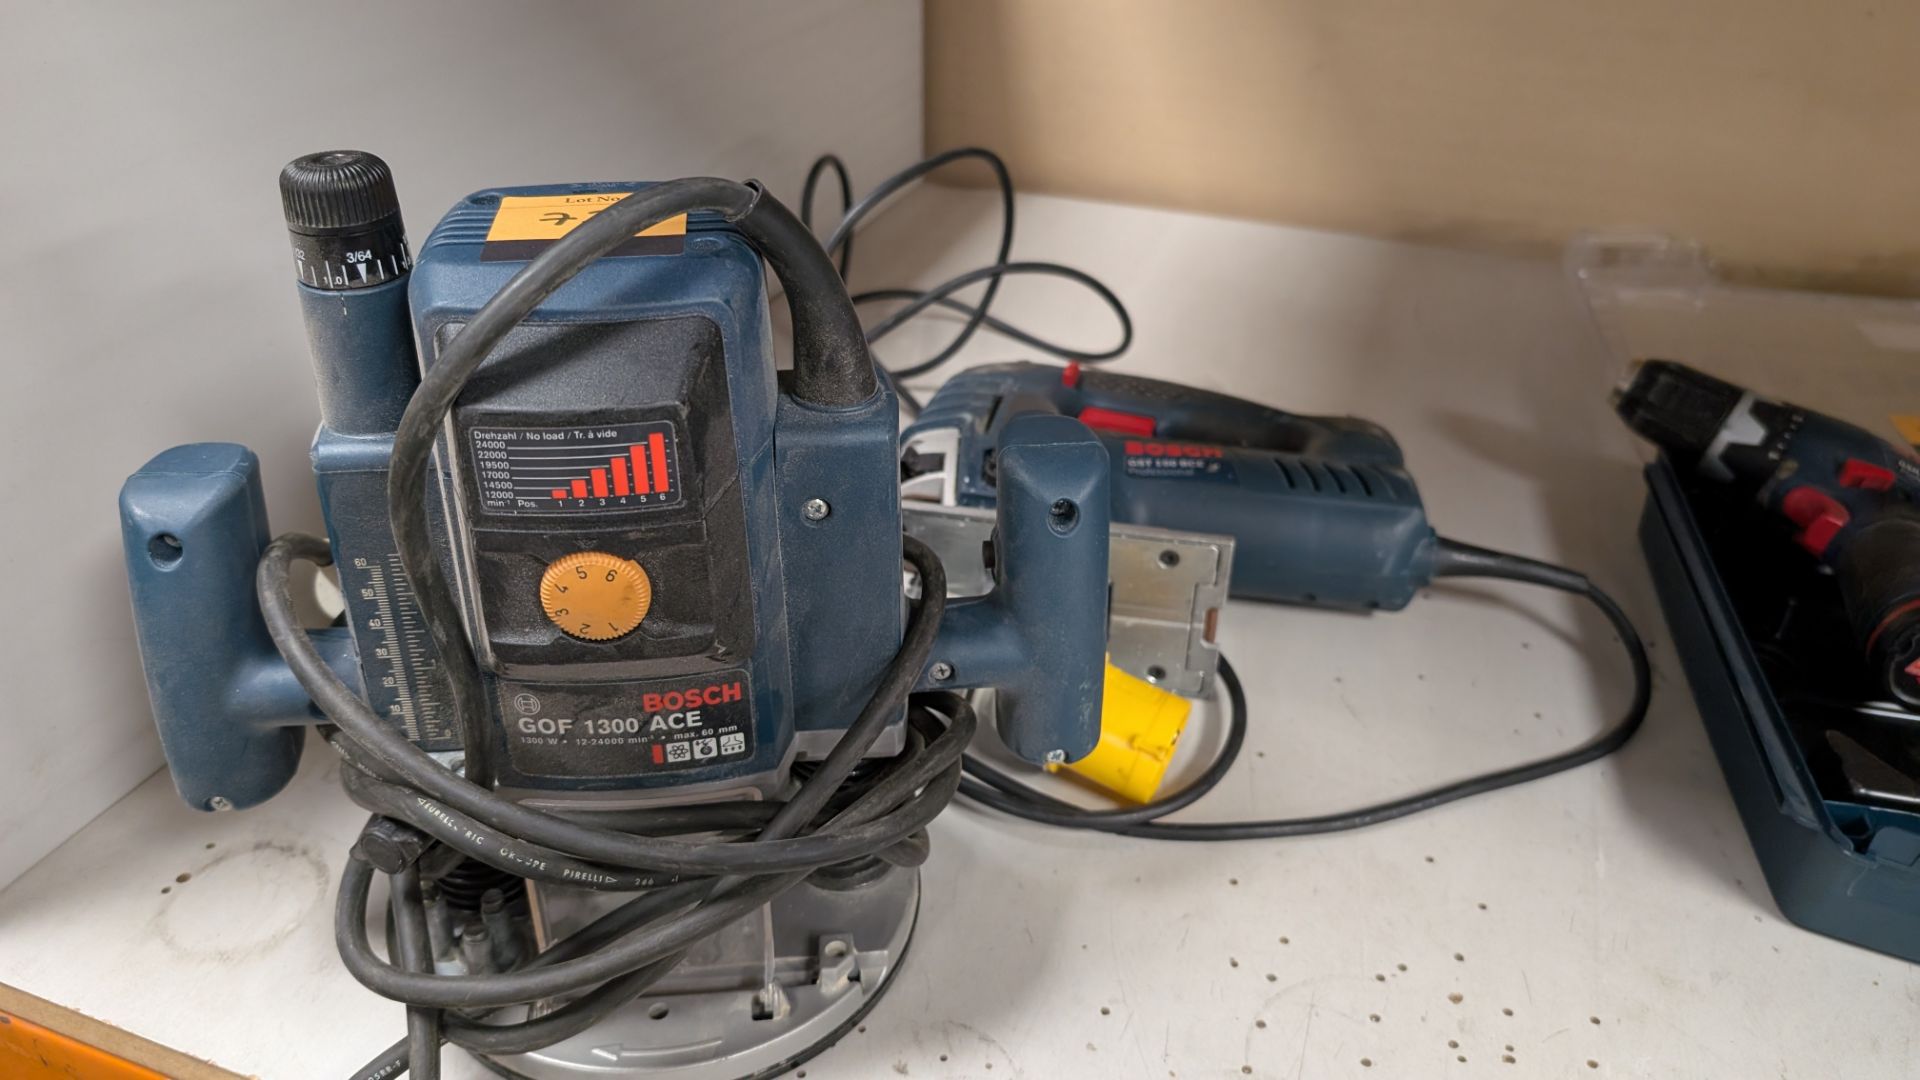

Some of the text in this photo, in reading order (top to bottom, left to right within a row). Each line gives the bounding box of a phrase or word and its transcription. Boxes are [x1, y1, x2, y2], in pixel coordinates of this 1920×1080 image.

[346, 249, 372, 264] 3/64
[474, 430, 517, 440] Drehzahl
[526, 432, 540, 440] No
[543, 432, 564, 440] load
[574, 431, 586, 439] Tr.
[588, 430, 594, 439] à
[597, 429, 617, 438] vide
[476, 441, 506, 449] 24000
[478, 451, 507, 459] 22000
[480, 461, 510, 469] 19500
[482, 471, 510, 479] 17000
[485, 491, 514, 499] 12000
[518, 500, 538, 508] Pos.
[354, 558, 367, 566] 60
[576, 566, 618, 582] 5 6
[362, 588, 374, 597] 50
[555, 584, 568, 593] 4
[555, 608, 569, 616] 3
[369, 619, 381, 627] 40
[580, 622, 618, 634] 2 1
[376, 648, 388, 656] 30
[382, 677, 394, 685] 20
[642, 682, 742, 713] BOSCH
[518, 711, 702, 734] GOF 1300 ACE
[576, 737, 624, 746] 12-24000
[674, 731, 699, 740] max.
[702, 728, 714, 736] 60
[719, 725, 738, 733] mm
[564, 868, 603, 883] PIRELLI
